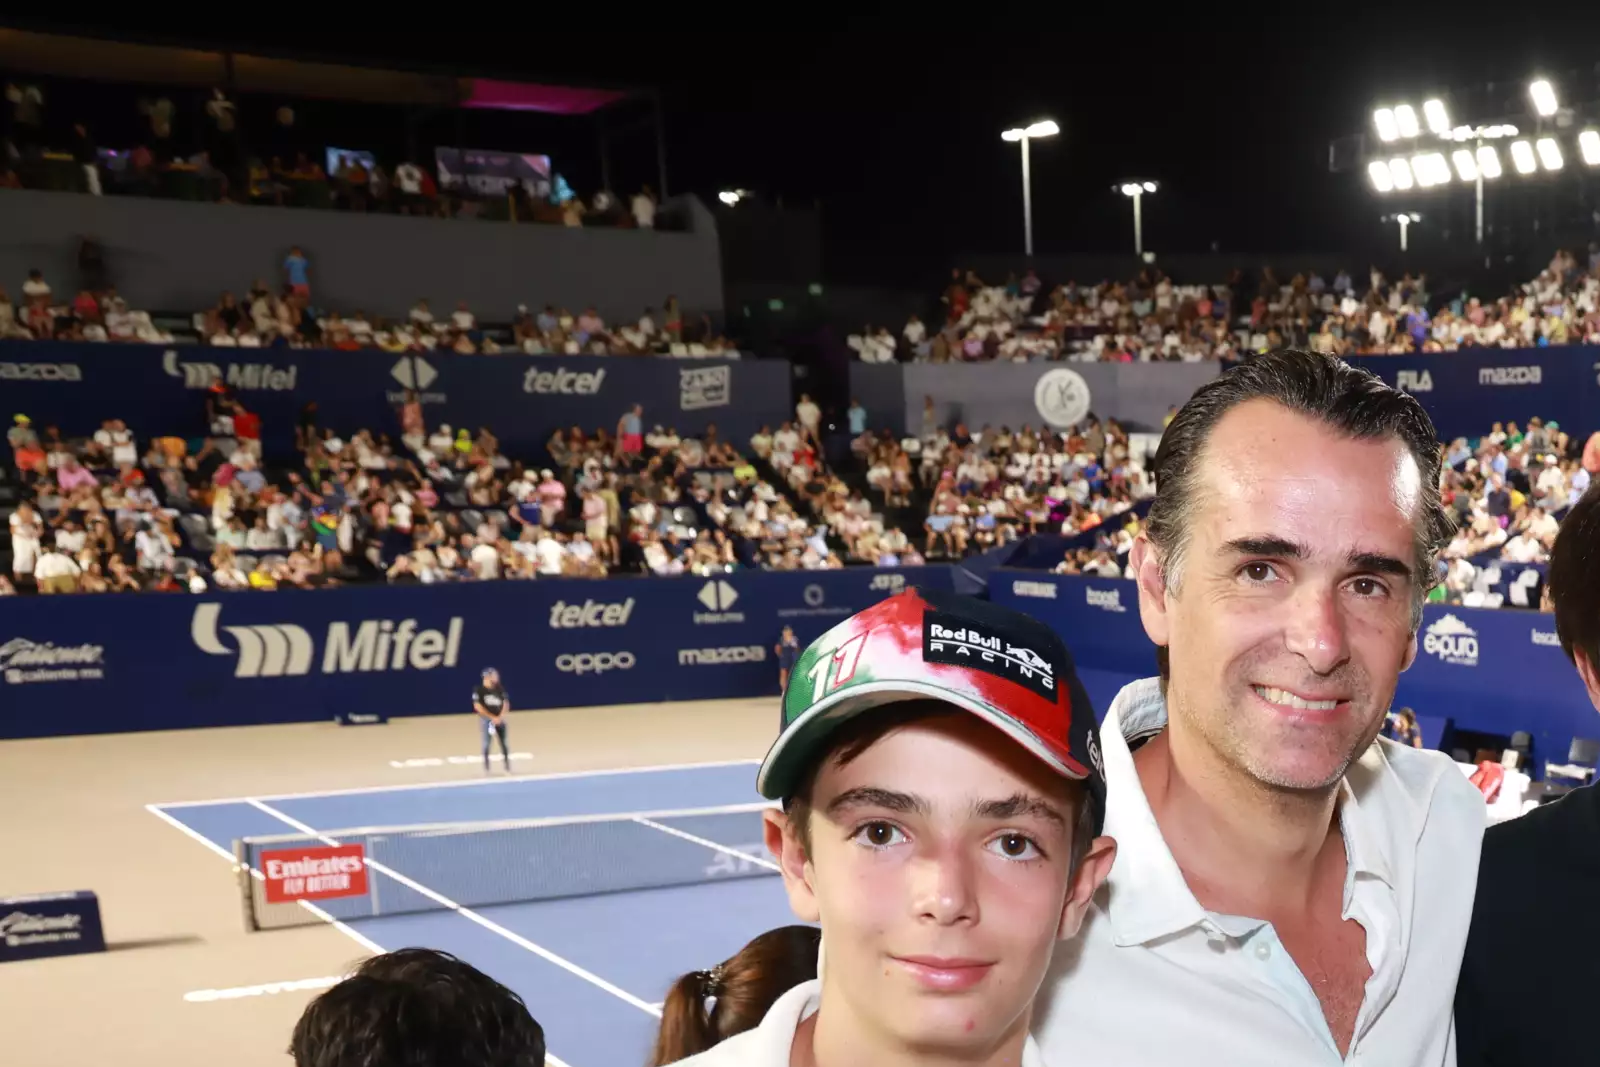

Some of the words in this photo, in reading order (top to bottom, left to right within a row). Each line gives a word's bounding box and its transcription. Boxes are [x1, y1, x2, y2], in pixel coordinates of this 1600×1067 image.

[0, 362, 82, 381] azda
[227, 362, 297, 390] Mifel
[523, 367, 605, 394] telcel
[1397, 369, 1433, 392] FILA
[549, 598, 635, 629] telcel
[321, 616, 463, 674] Mifel
[930, 624, 966, 642] Red
[968, 630, 1001, 651] Bull
[556, 651, 635, 674] oppo
[930, 642, 1054, 690] RACING
[266, 855, 363, 880] Emirates
